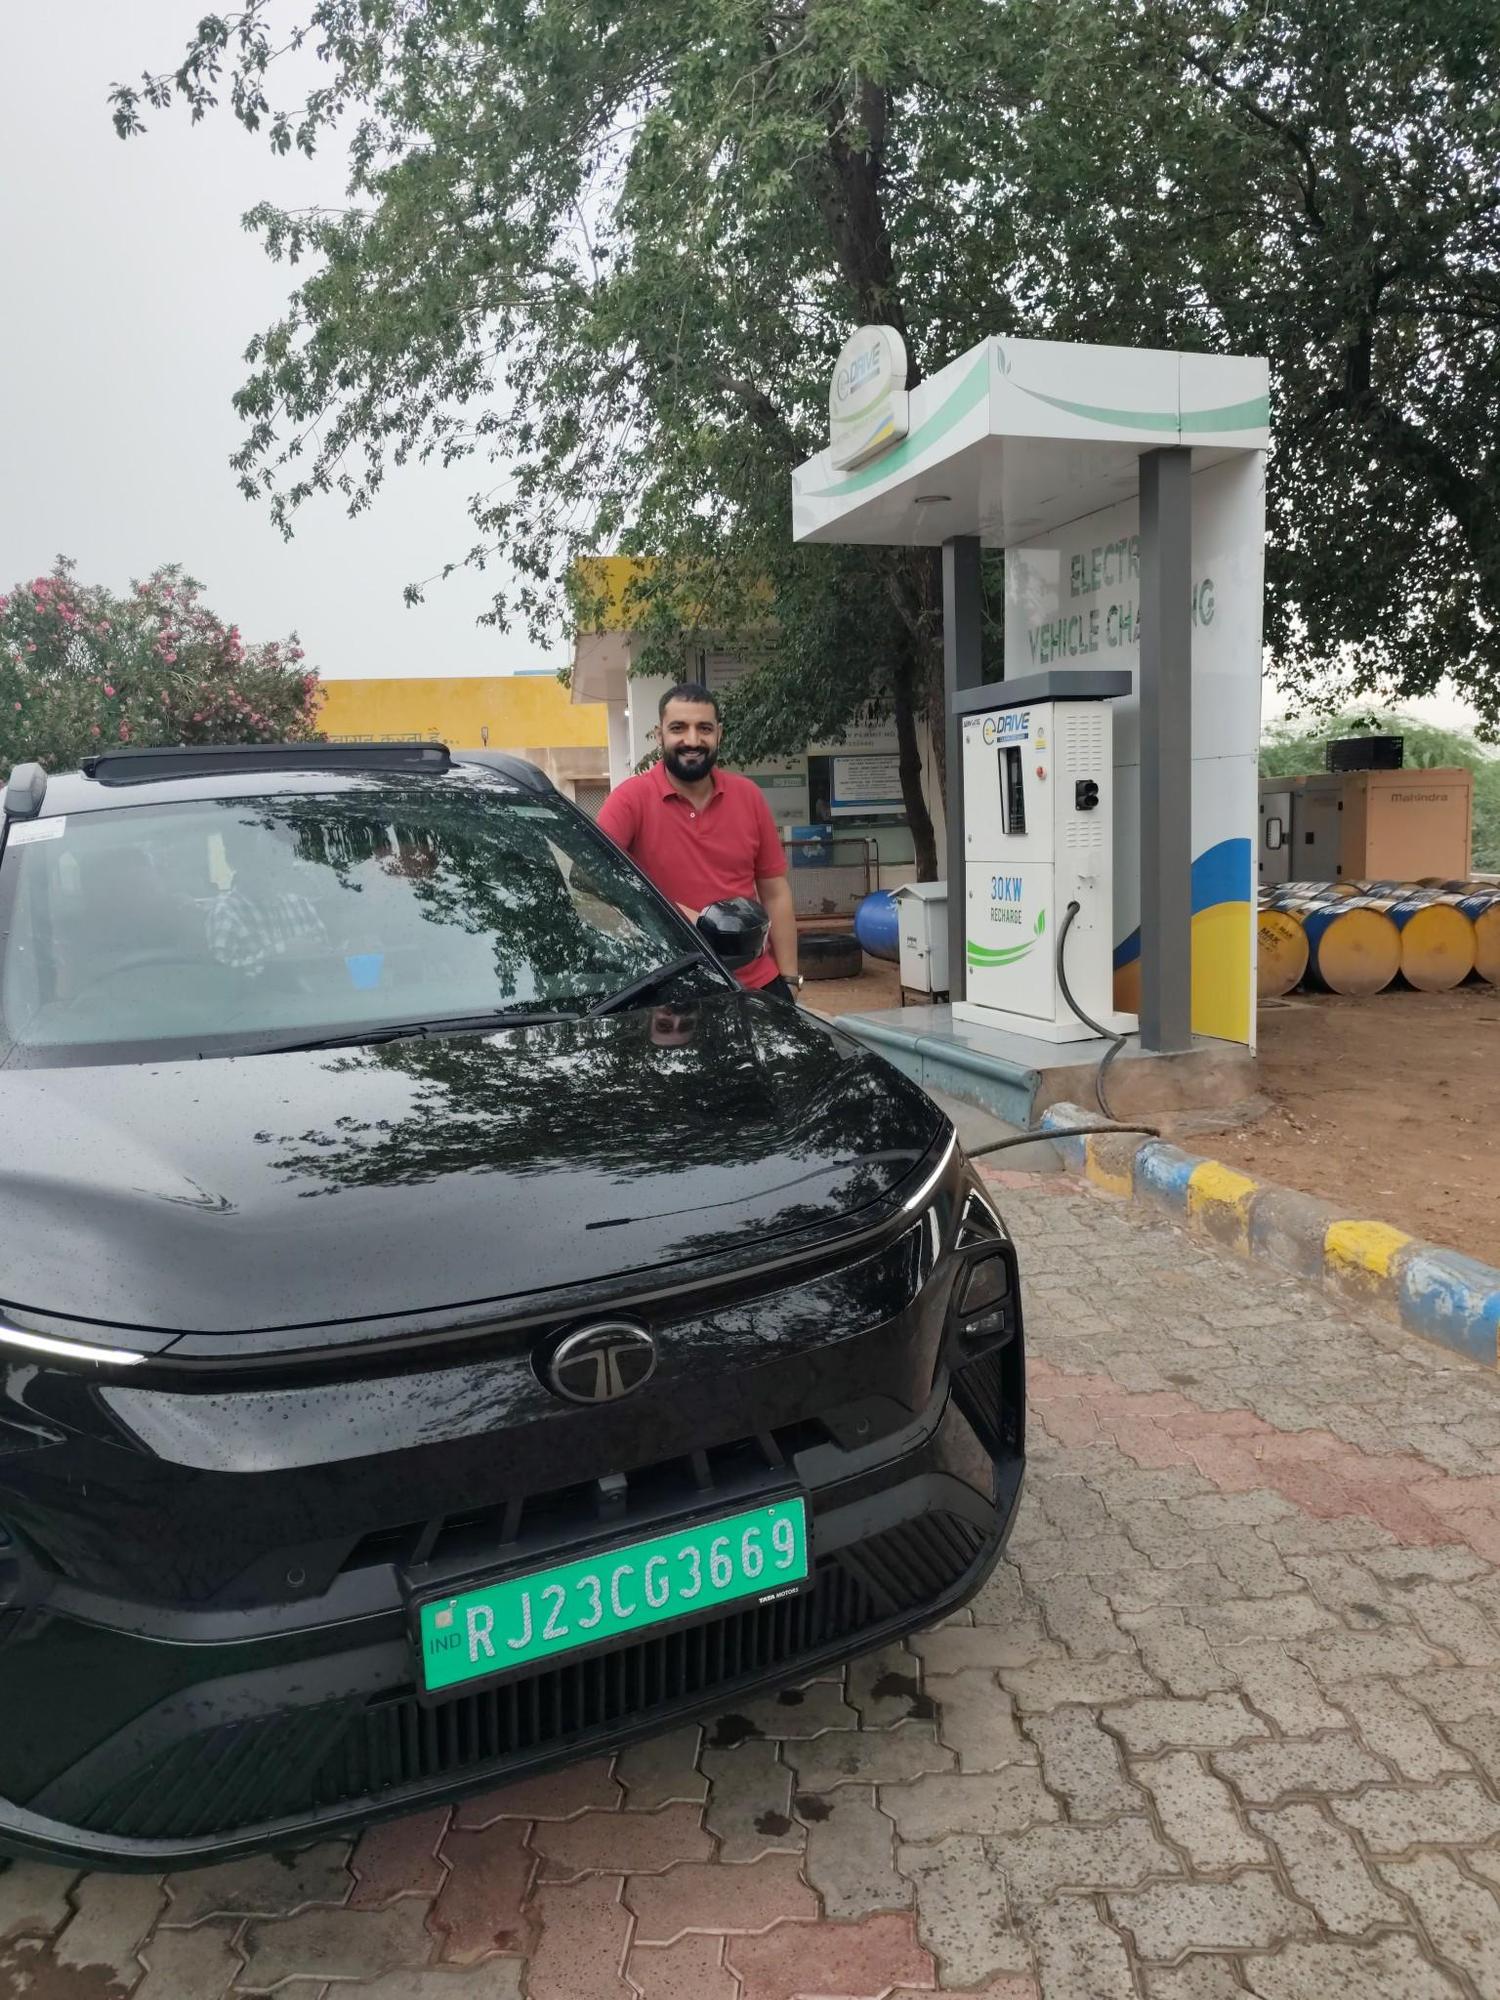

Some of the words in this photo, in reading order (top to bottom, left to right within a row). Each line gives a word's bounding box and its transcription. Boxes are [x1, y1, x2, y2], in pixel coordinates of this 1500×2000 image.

[1071, 534, 1140, 598] ELECTR
[1028, 609, 1099, 666] VEHICLE
[1391, 793, 1448, 803] Mahindra
[991, 876, 1022, 902] 30KW
[991, 907, 1022, 925] RECHARGE
[466, 1517, 796, 1663] RJ23CG3669
[759, 1594, 775, 1603] TATA
[776, 1587, 799, 1599] MOTORS
[430, 1632, 462, 1655] IND
